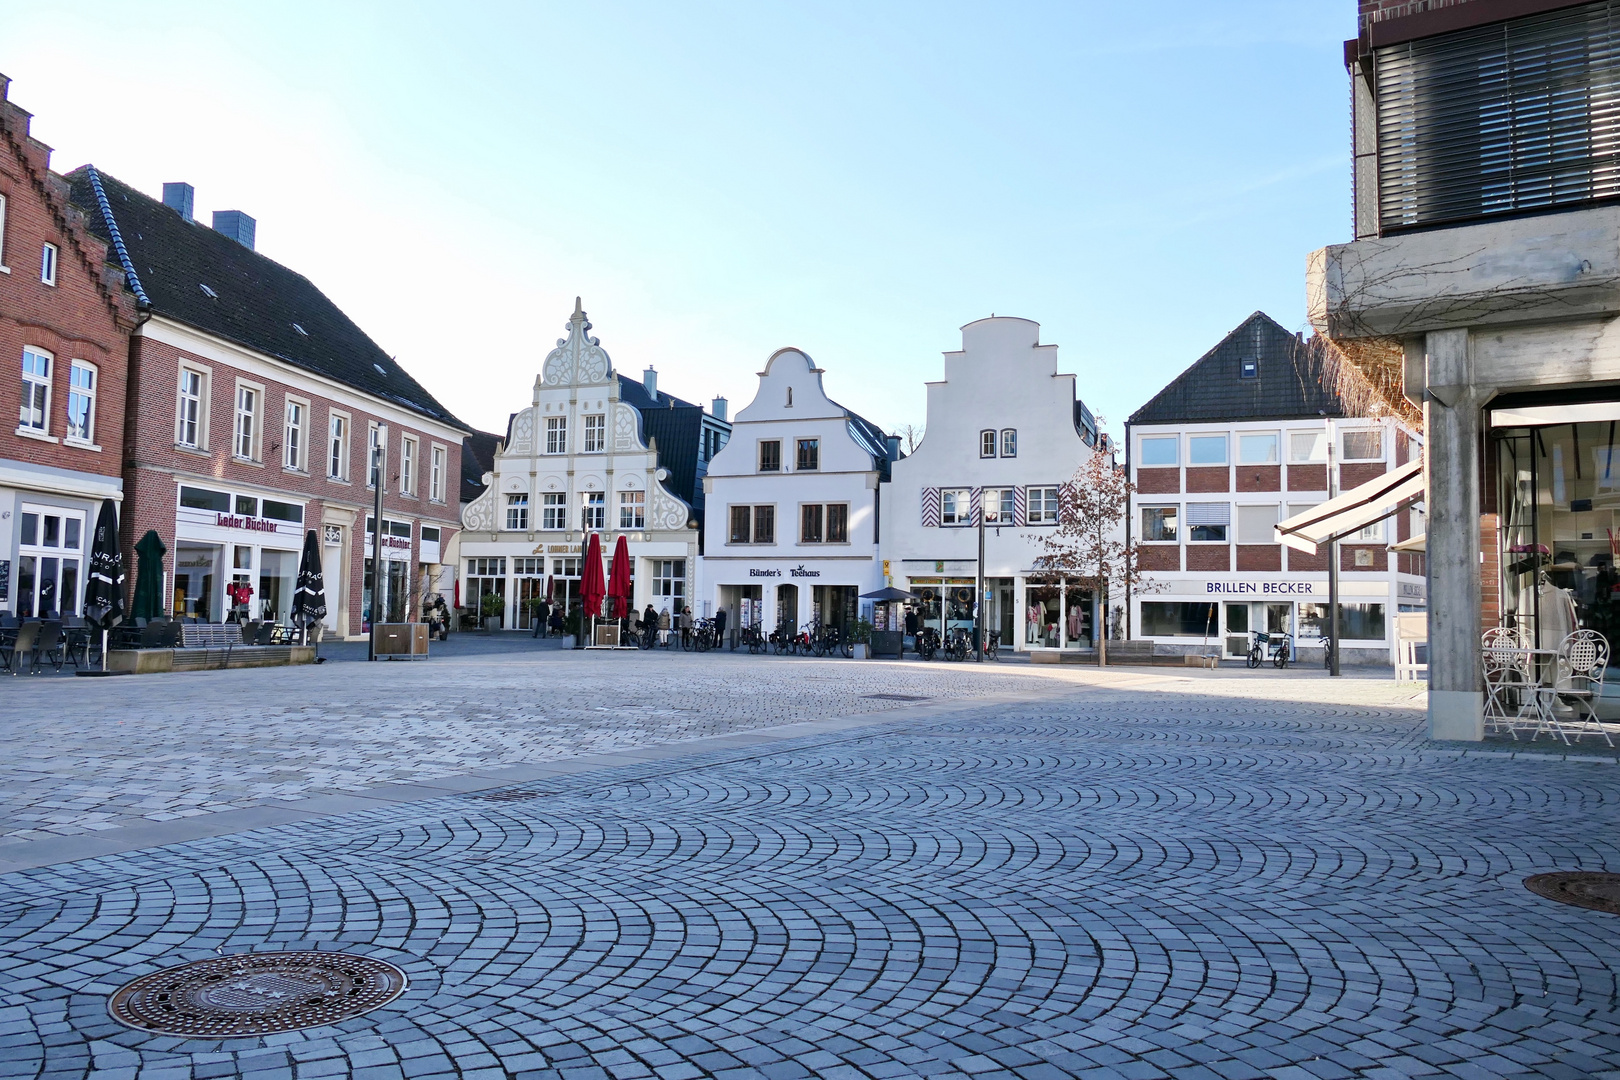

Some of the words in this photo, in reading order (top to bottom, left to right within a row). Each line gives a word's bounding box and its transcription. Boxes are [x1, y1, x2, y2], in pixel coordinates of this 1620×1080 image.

[217, 512, 244, 529] Leder
[245, 516, 278, 533] Büchter
[547, 545, 569, 554] LOHNER
[749, 568, 782, 577] Bünder's
[789, 568, 821, 577] Teehaus
[1206, 582, 1257, 594] BRILLEN
[1262, 582, 1313, 594] BECKER
